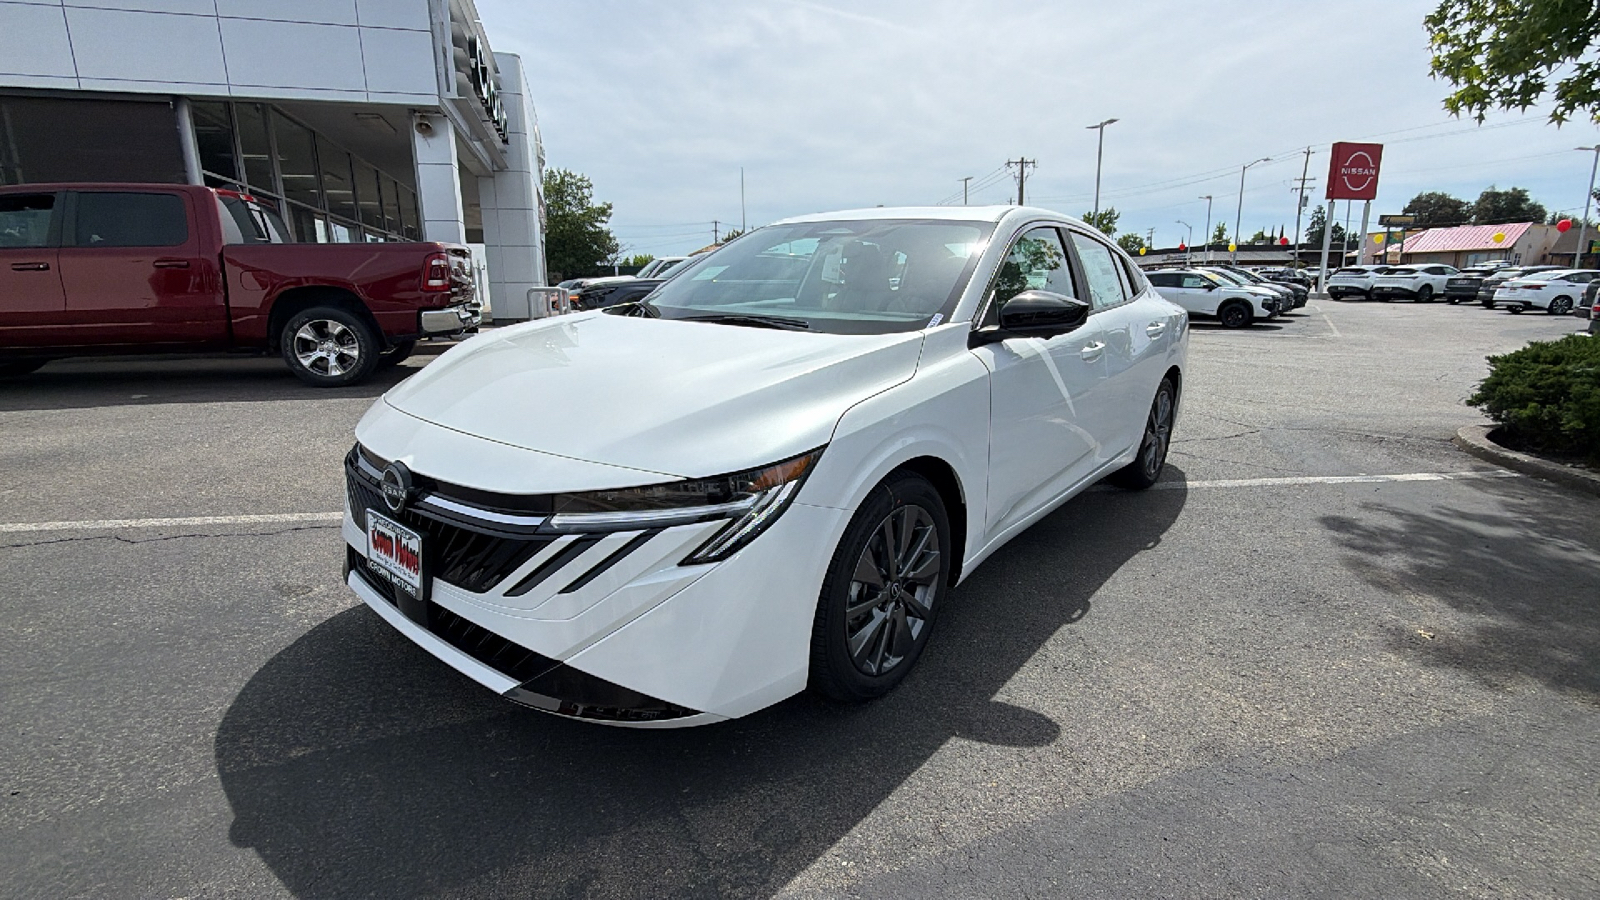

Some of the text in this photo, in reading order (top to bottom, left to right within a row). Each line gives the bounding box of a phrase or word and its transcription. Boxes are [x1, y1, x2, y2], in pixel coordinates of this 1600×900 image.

[1341, 167, 1375, 175] NISSAN
[383, 484, 406, 499] SSAN
[369, 561, 391, 580] CROWN
[391, 574, 417, 597] MOTORS
